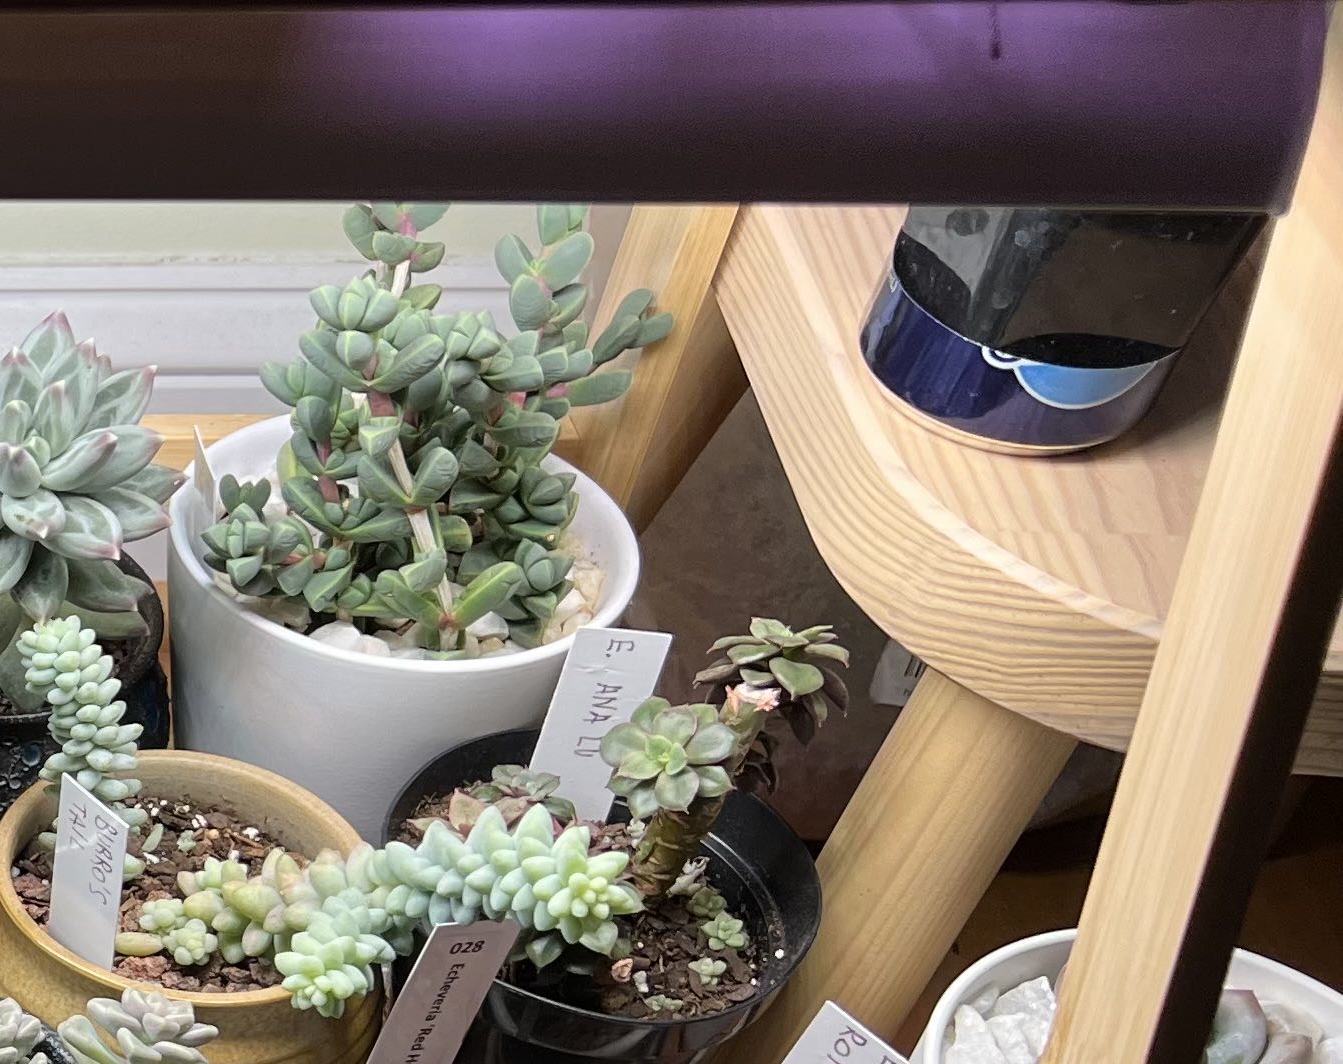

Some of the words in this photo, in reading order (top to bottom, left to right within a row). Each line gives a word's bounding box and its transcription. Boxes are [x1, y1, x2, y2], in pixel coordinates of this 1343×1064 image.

[605, 638, 635, 658] E.
[582, 682, 623, 724] ANA
[68, 802, 89, 851] TAIL
[88, 814, 118, 906] BURRO'S
[448, 940, 486, 955] 028
[424, 963, 465, 1022] Echeveria
